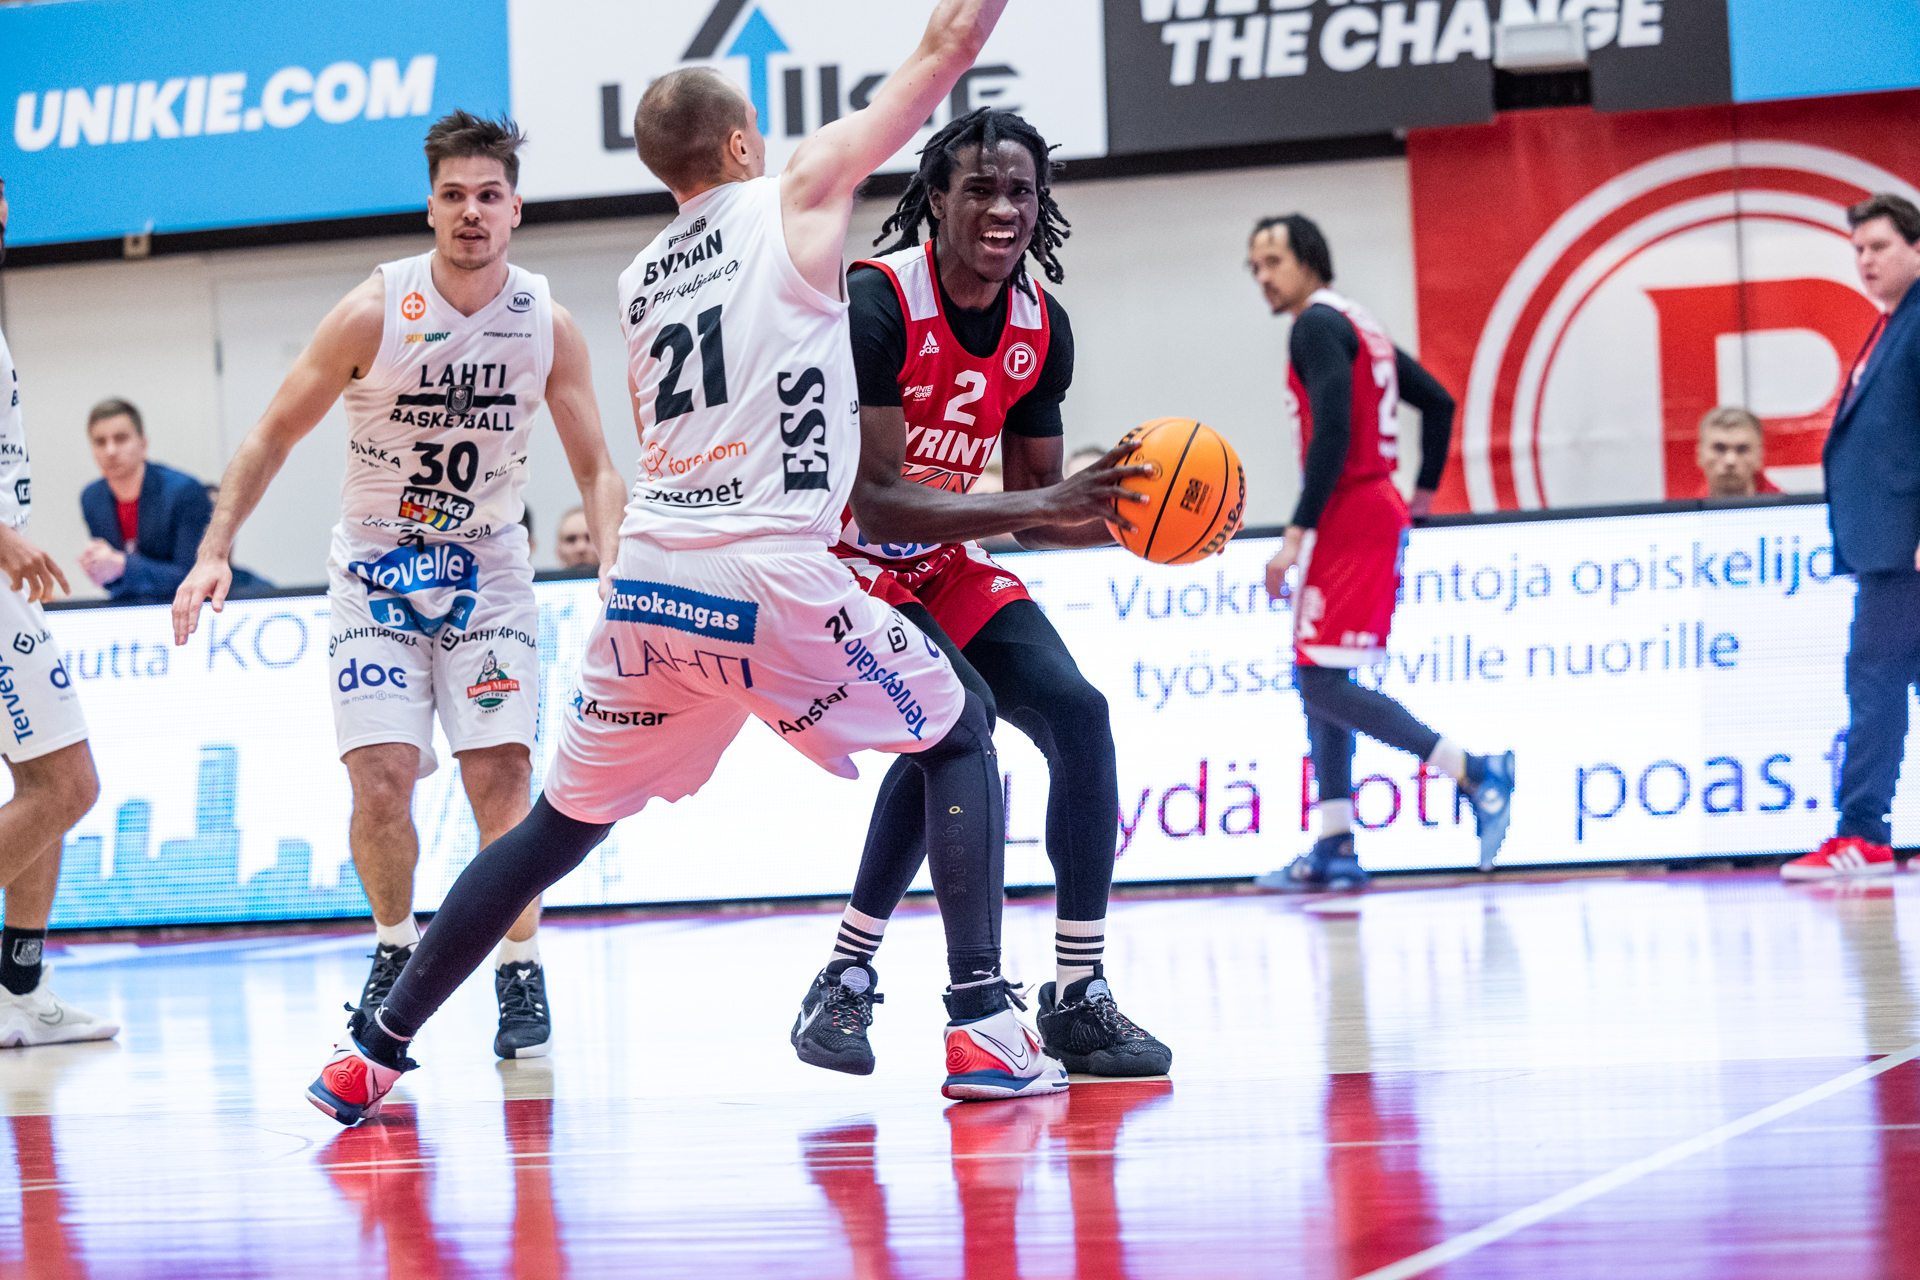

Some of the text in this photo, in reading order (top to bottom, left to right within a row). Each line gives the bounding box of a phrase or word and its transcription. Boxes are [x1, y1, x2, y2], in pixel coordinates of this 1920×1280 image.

[1161, 12, 1312, 86] THE
[13, 54, 437, 152] UNIKIE.COM
[404, 331, 451, 344] SUBWAY
[419, 363, 506, 388] LAHTI
[650, 304, 728, 427] 21
[1013, 350, 1029, 372] P
[944, 370, 987, 426] 2
[390, 408, 515, 431] BASKETBALL
[777, 367, 830, 494] ESS
[409, 441, 479, 491] 30
[402, 489, 470, 519] rukka
[357, 546, 464, 589] Novelle
[610, 588, 739, 630] Eurokangas
[825, 606, 853, 643] 21
[1527, 621, 1741, 676] nuorille
[338, 658, 407, 692] doc
[585, 700, 668, 726] Anstar
[778, 683, 848, 735] Anstar
